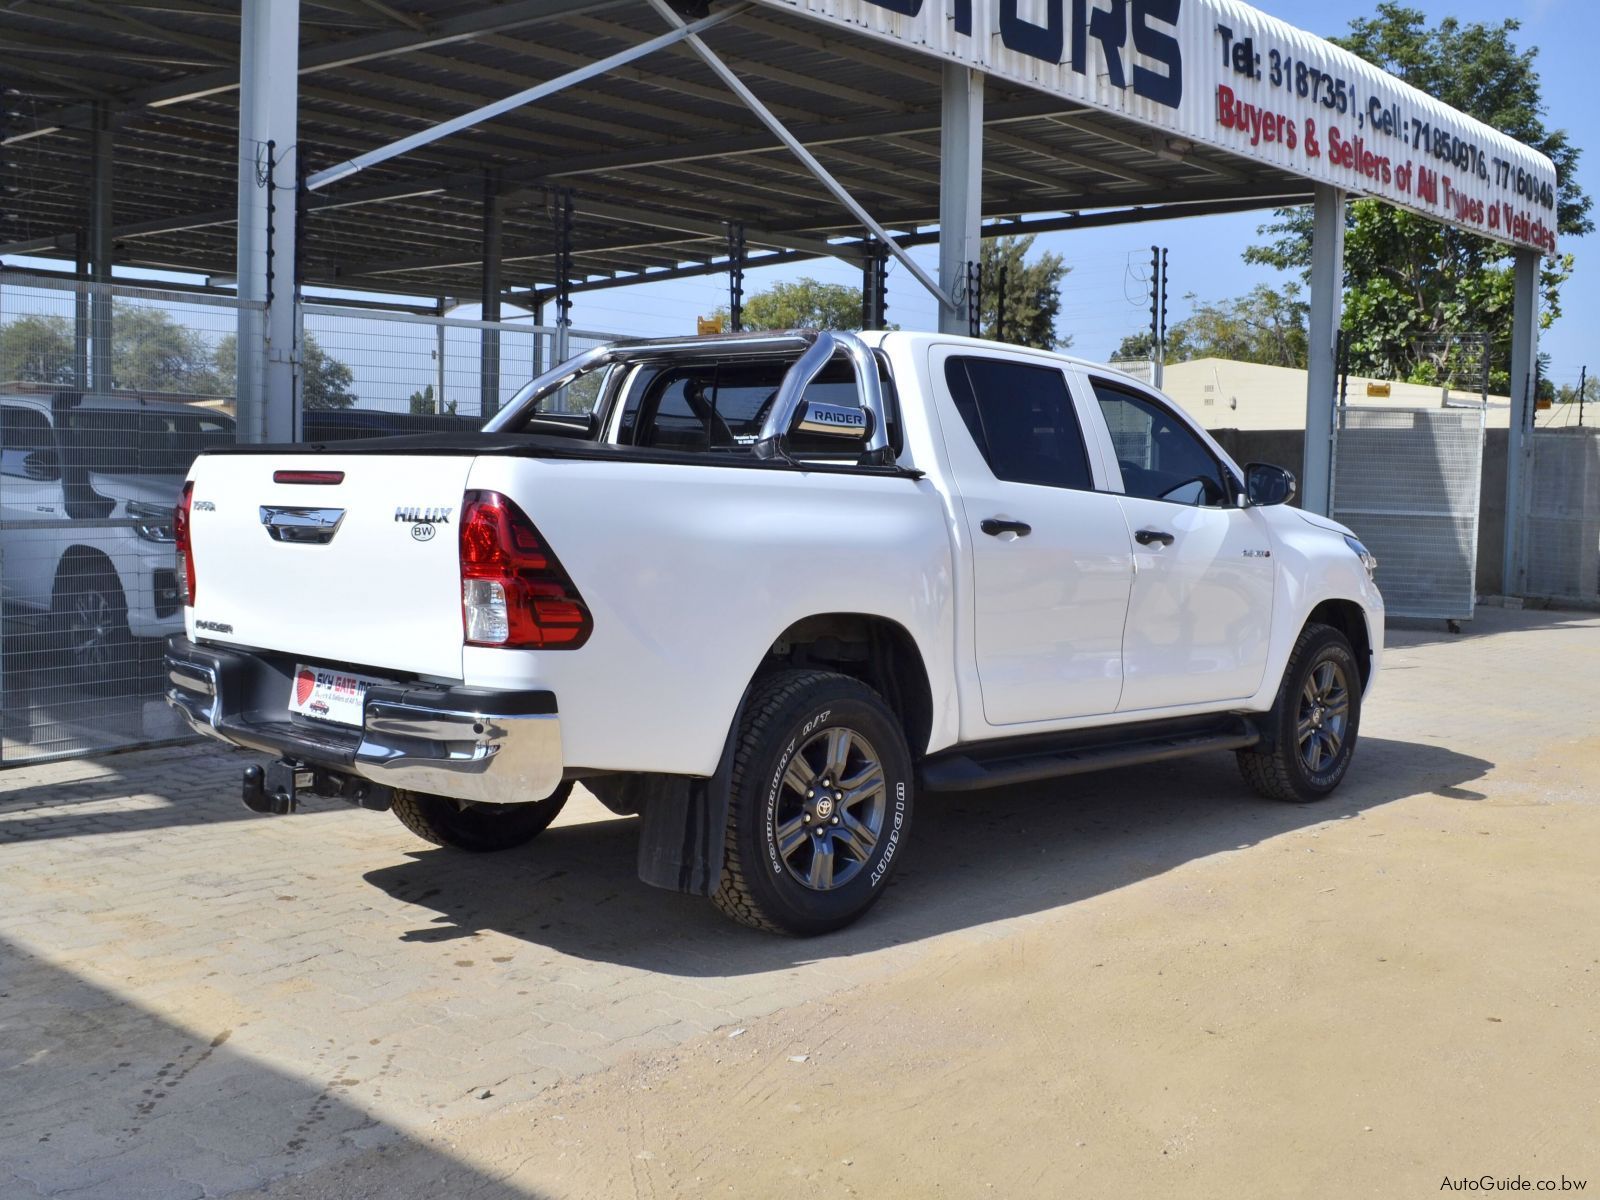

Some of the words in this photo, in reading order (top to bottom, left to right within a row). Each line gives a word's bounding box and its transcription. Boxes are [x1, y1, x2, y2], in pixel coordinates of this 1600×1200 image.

[1217, 23, 1261, 81] Tel:
[1218, 84, 1297, 146] Buyers
[1304, 117, 1320, 158] &
[1328, 126, 1391, 184] Sellers
[1396, 160, 1412, 194] of
[1417, 165, 1437, 205] All
[1442, 175, 1484, 222] Types
[1503, 202, 1556, 253] Vehicles
[814, 410, 862, 425] RAIDER
[394, 506, 453, 523] HILUX
[414, 527, 432, 536] BW
[335, 675, 357, 696] GATE
